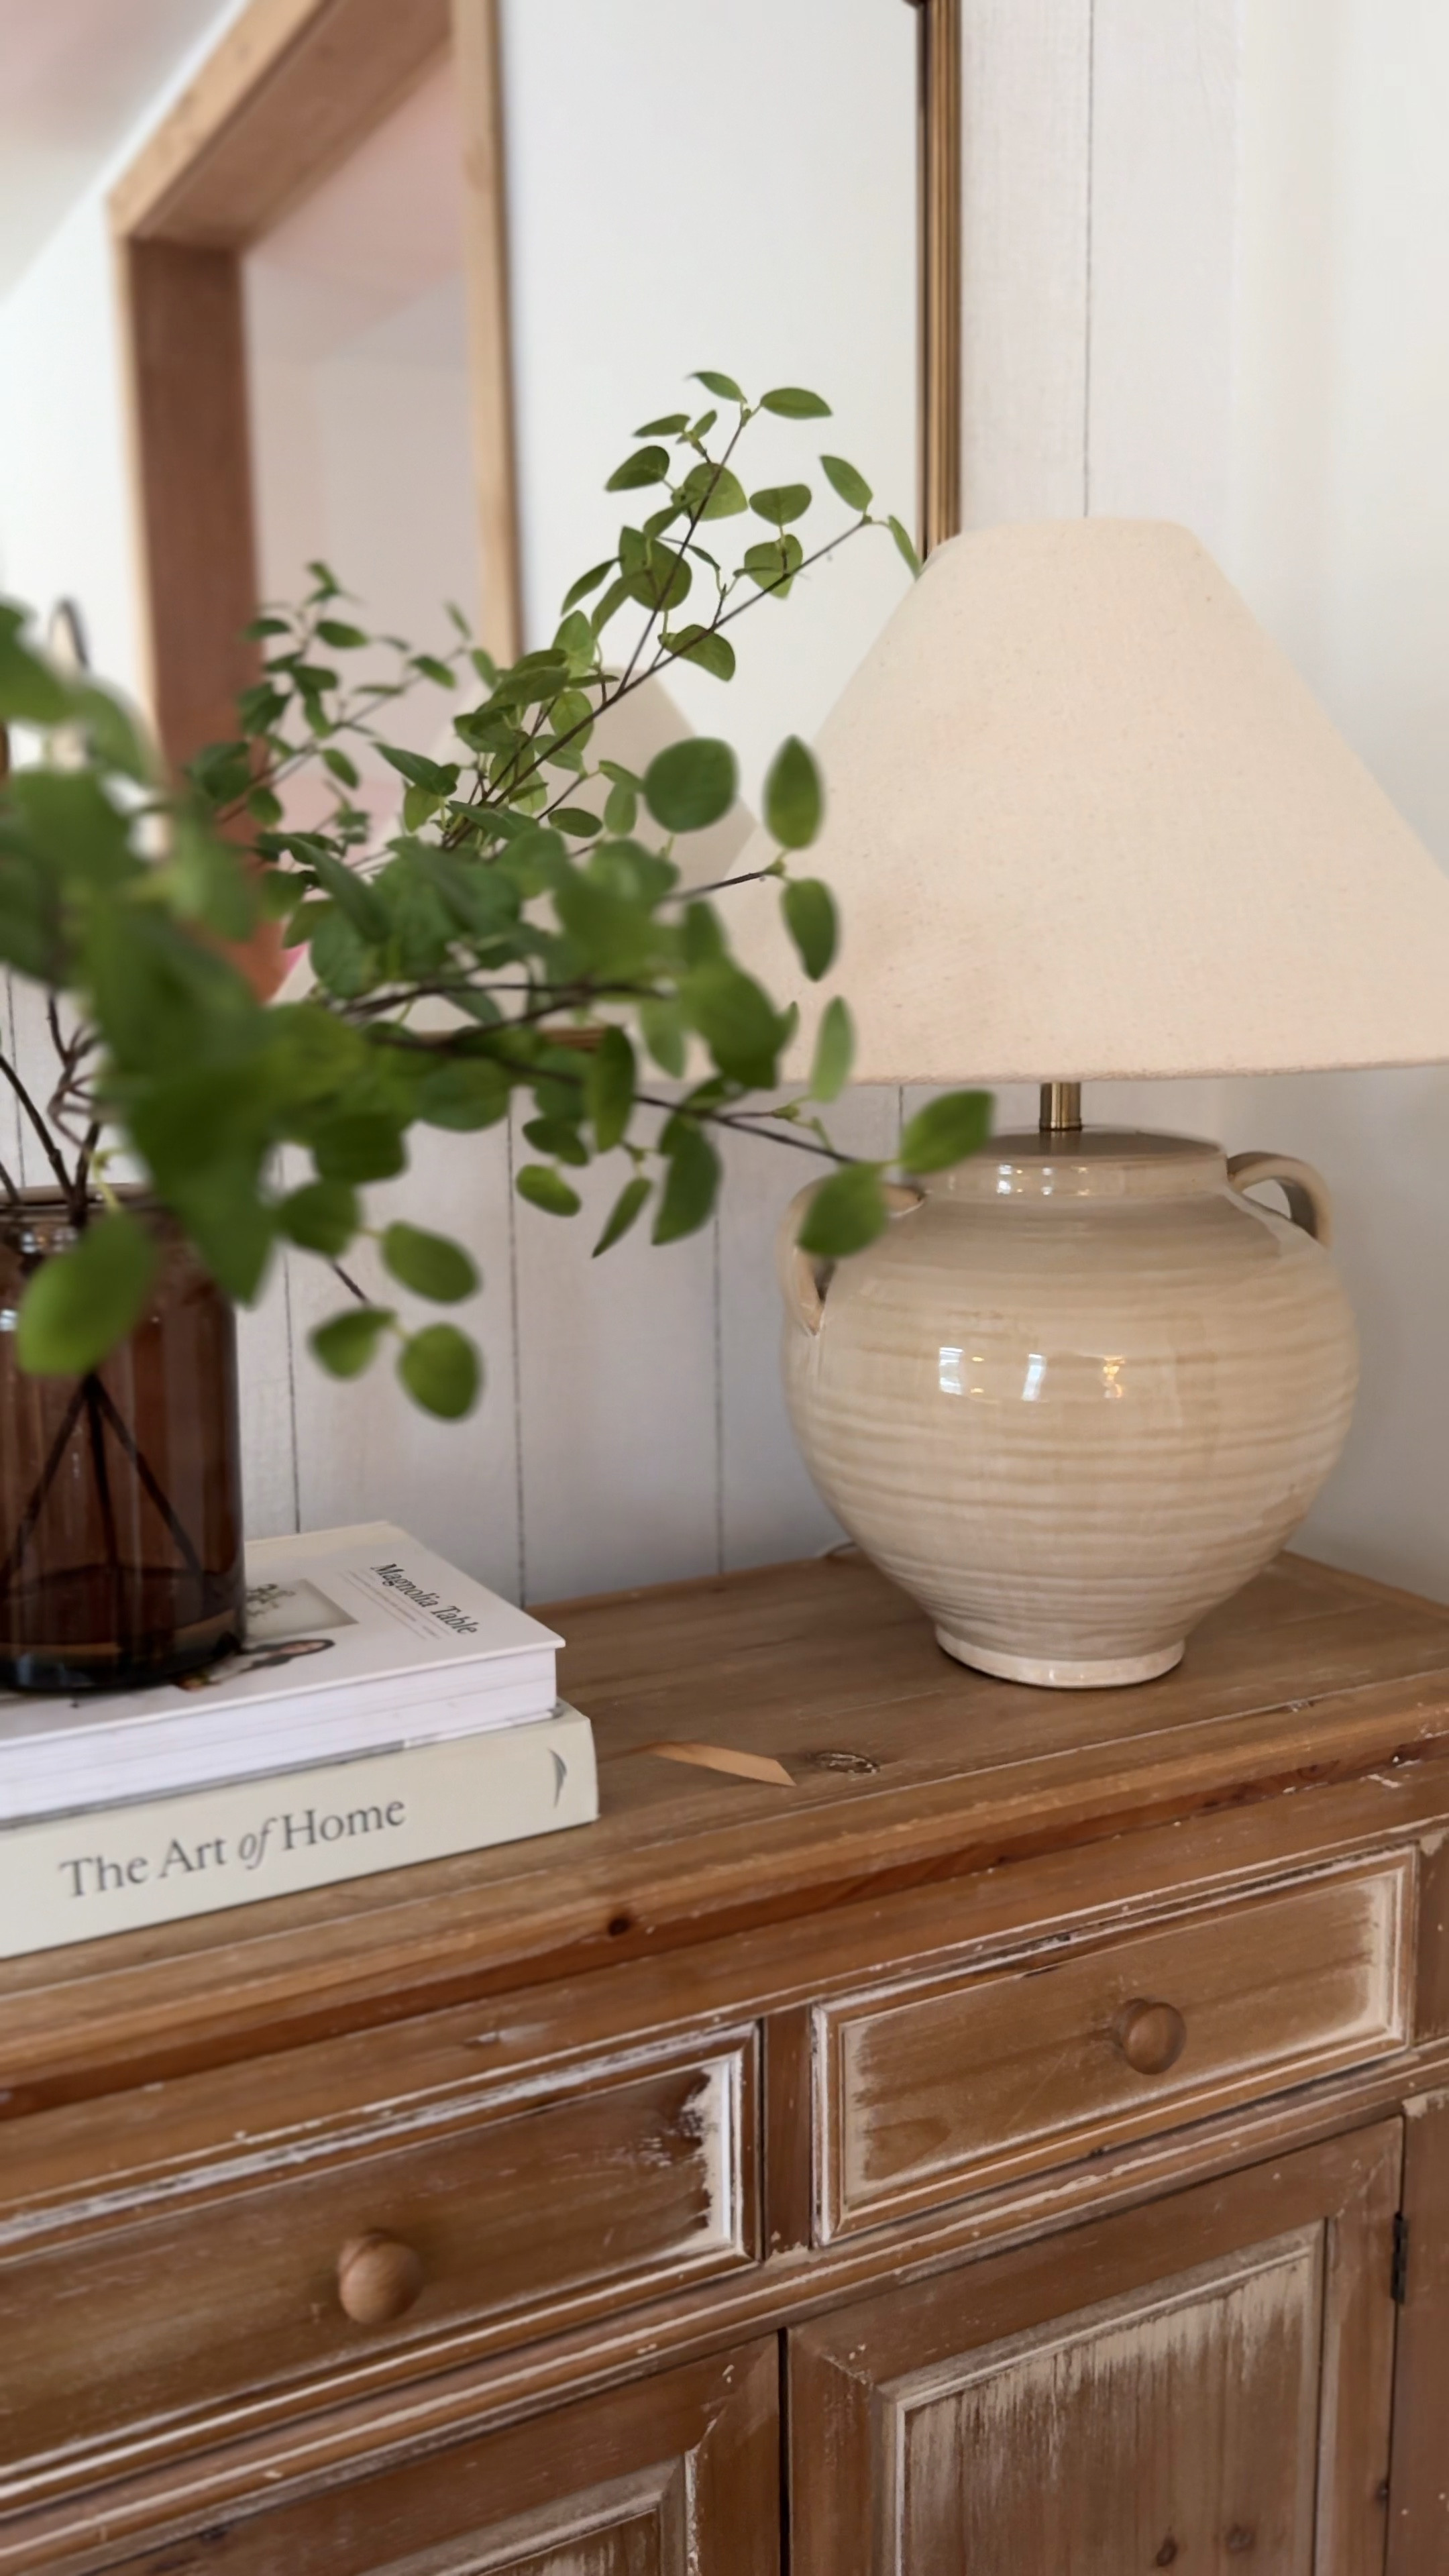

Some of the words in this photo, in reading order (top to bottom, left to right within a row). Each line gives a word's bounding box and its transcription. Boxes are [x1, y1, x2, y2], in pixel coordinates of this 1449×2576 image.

[370, 1563, 440, 1608] Magnolia
[429, 1605, 479, 1634] Table
[59, 1855, 148, 1898] The
[158, 1839, 227, 1878] Art
[238, 1817, 278, 1870] of
[280, 1799, 406, 1851] Home
